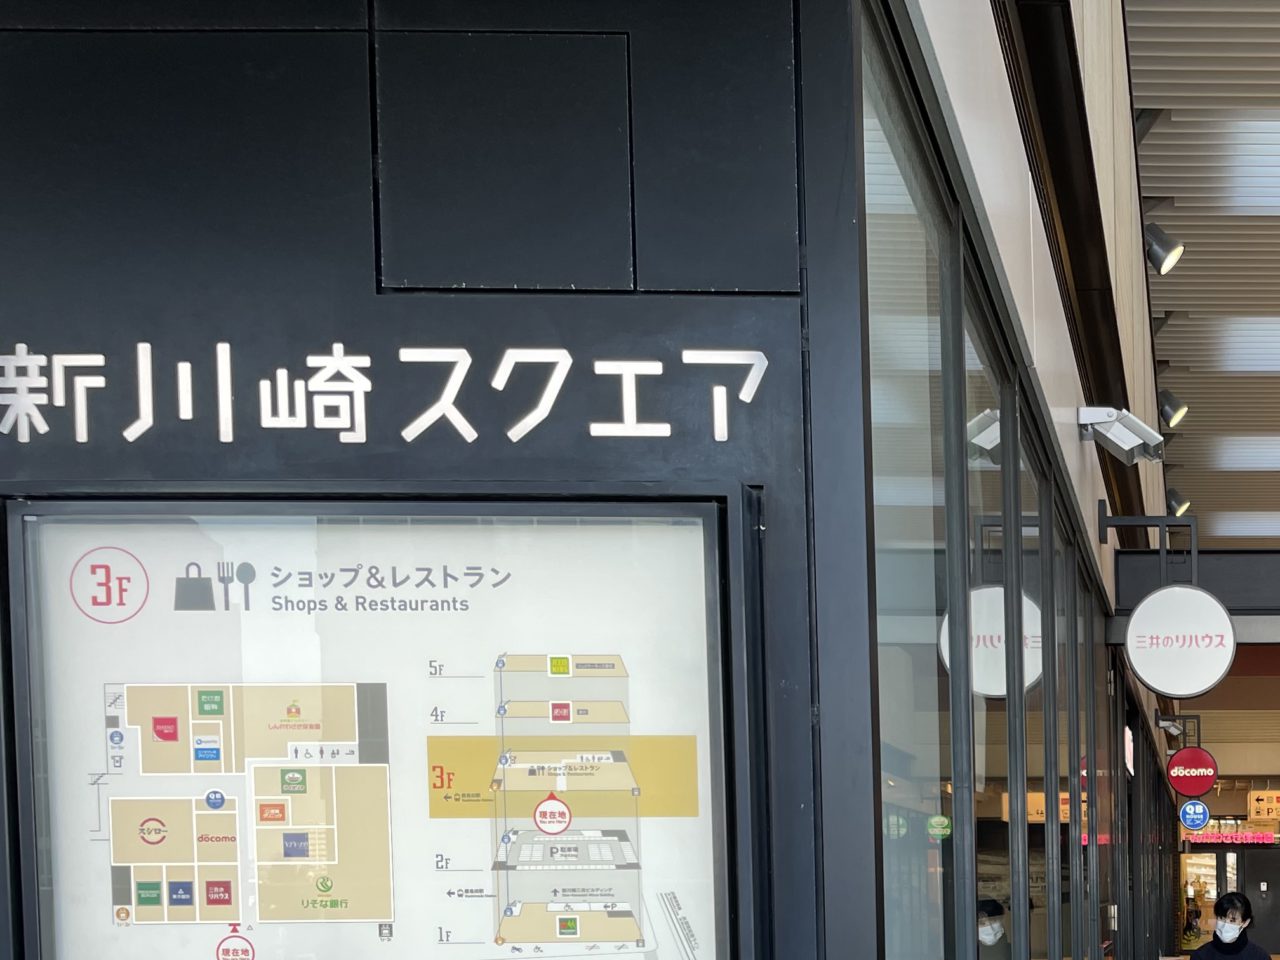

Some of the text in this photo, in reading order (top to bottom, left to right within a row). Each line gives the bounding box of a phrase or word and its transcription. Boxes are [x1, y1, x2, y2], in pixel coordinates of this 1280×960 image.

[0, 342, 768, 444] 新川崎スクエア
[91, 562, 132, 607] 3F
[269, 565, 512, 589] ショップ&レストラン
[271, 595, 470, 615] Shops & Restaurants
[1135, 633, 1226, 649] 三井のリハウス
[429, 660, 444, 676] 5F
[430, 706, 446, 722] 4F
[432, 765, 455, 789] 3F
[1170, 766, 1214, 777] docomo
[539, 811, 567, 819] 現在地
[1186, 804, 1204, 813] QB
[197, 833, 237, 843] docomo
[436, 854, 451, 869] 2F
[301, 899, 349, 909] りそな銀行
[438, 927, 452, 942] 1F
[221, 948, 250, 957] 現在地
